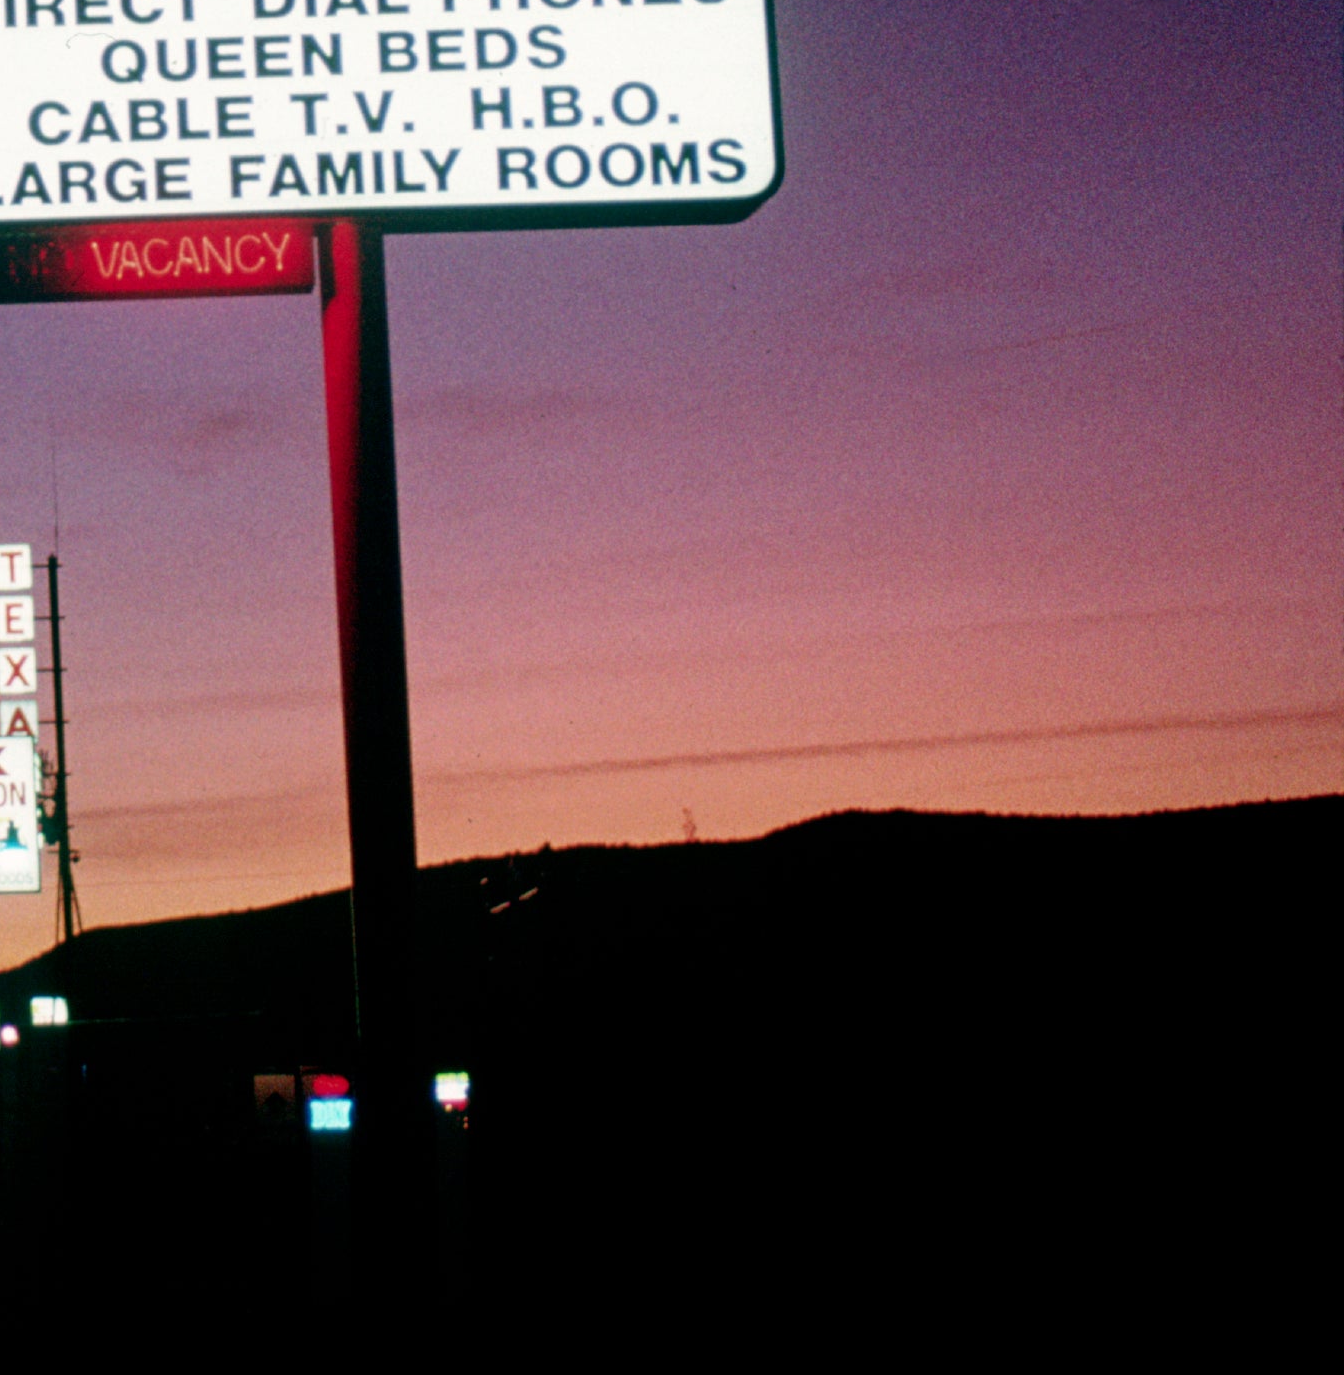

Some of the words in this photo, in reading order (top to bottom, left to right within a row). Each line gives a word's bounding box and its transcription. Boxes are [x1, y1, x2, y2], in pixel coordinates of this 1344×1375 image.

[101, 33, 343, 84] QUEEN
[378, 25, 566, 73] BEDS
[29, 96, 255, 146] CABLE
[290, 91, 414, 136] T.V.
[471, 81, 679, 130] H.B.O.
[230, 148, 460, 198] FAMILY
[497, 138, 747, 190] ROOMS
[90, 232, 290, 280] VACANCY
[0, 551, 35, 737] TEXA
